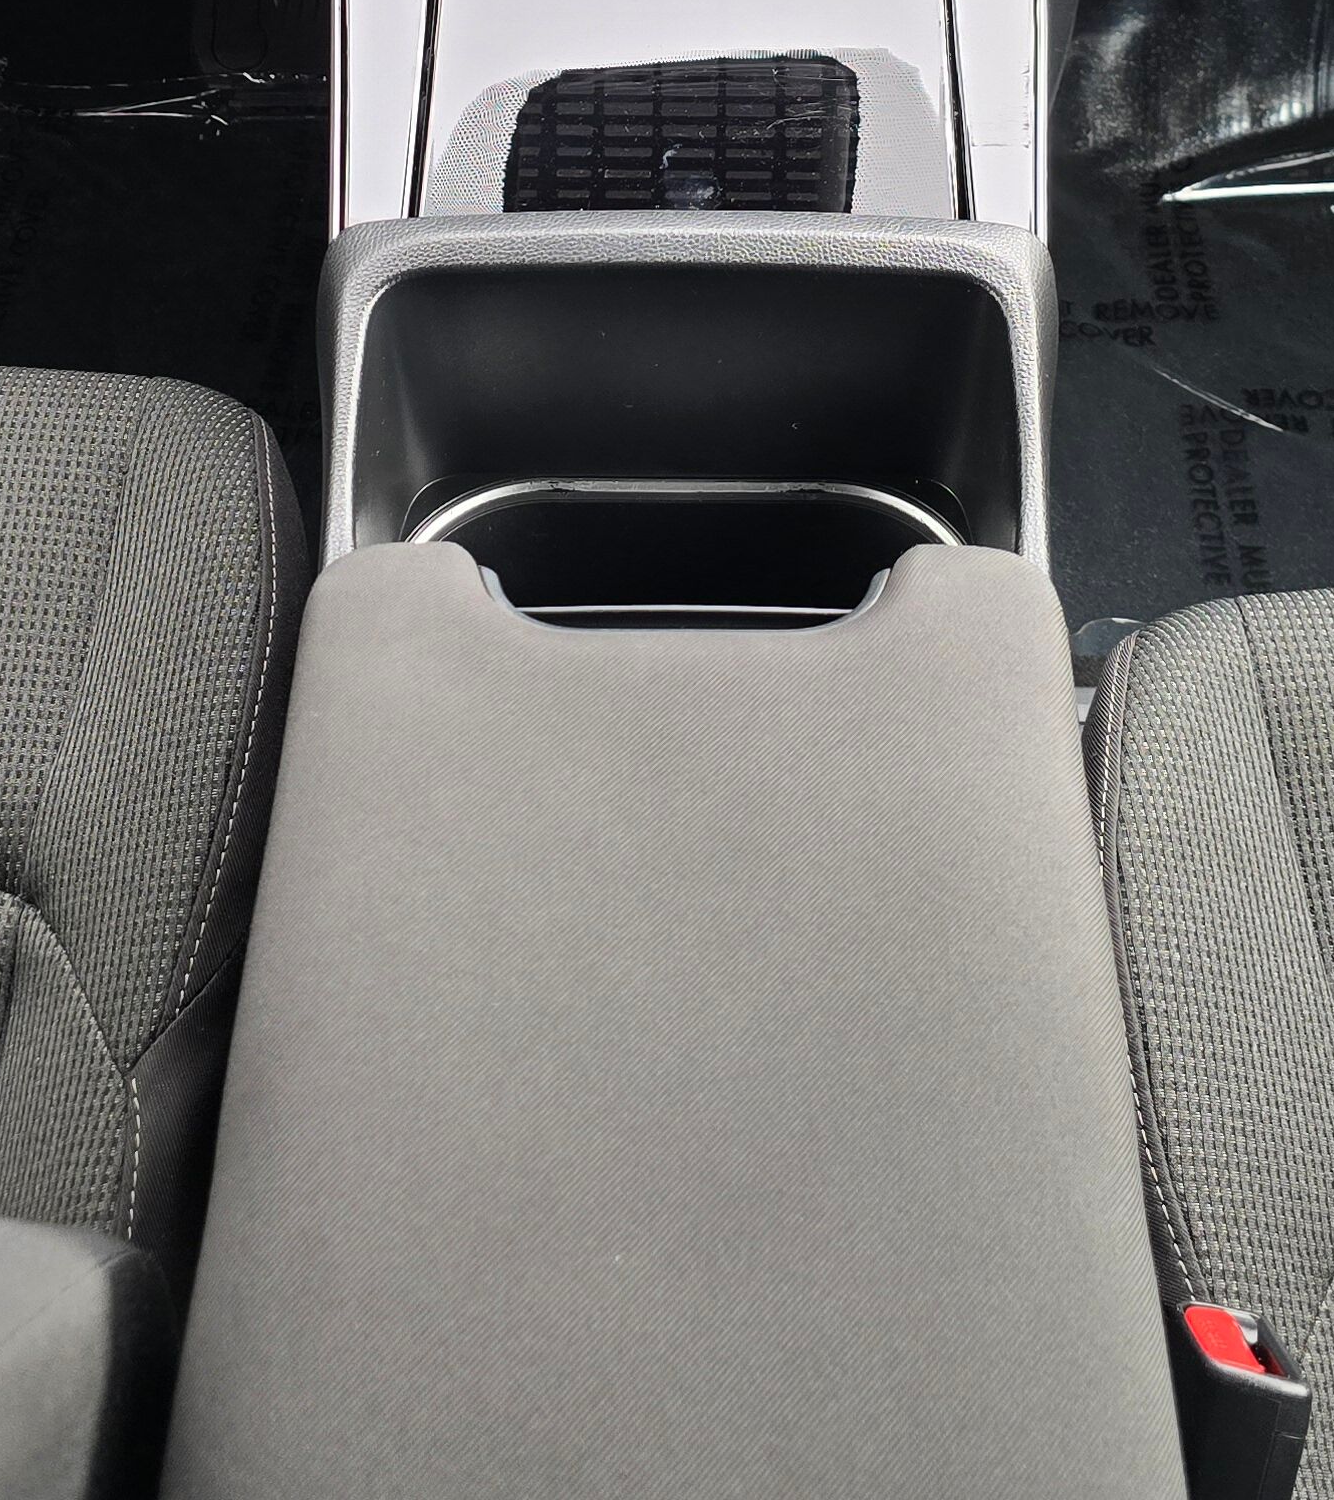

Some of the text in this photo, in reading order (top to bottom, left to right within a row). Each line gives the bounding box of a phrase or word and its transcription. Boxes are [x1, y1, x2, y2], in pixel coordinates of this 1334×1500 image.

[1093, 301, 1219, 322] REMOVE
[1182, 431, 1231, 587] PROTECTIVE
[1220, 429, 1258, 526] DEALER
